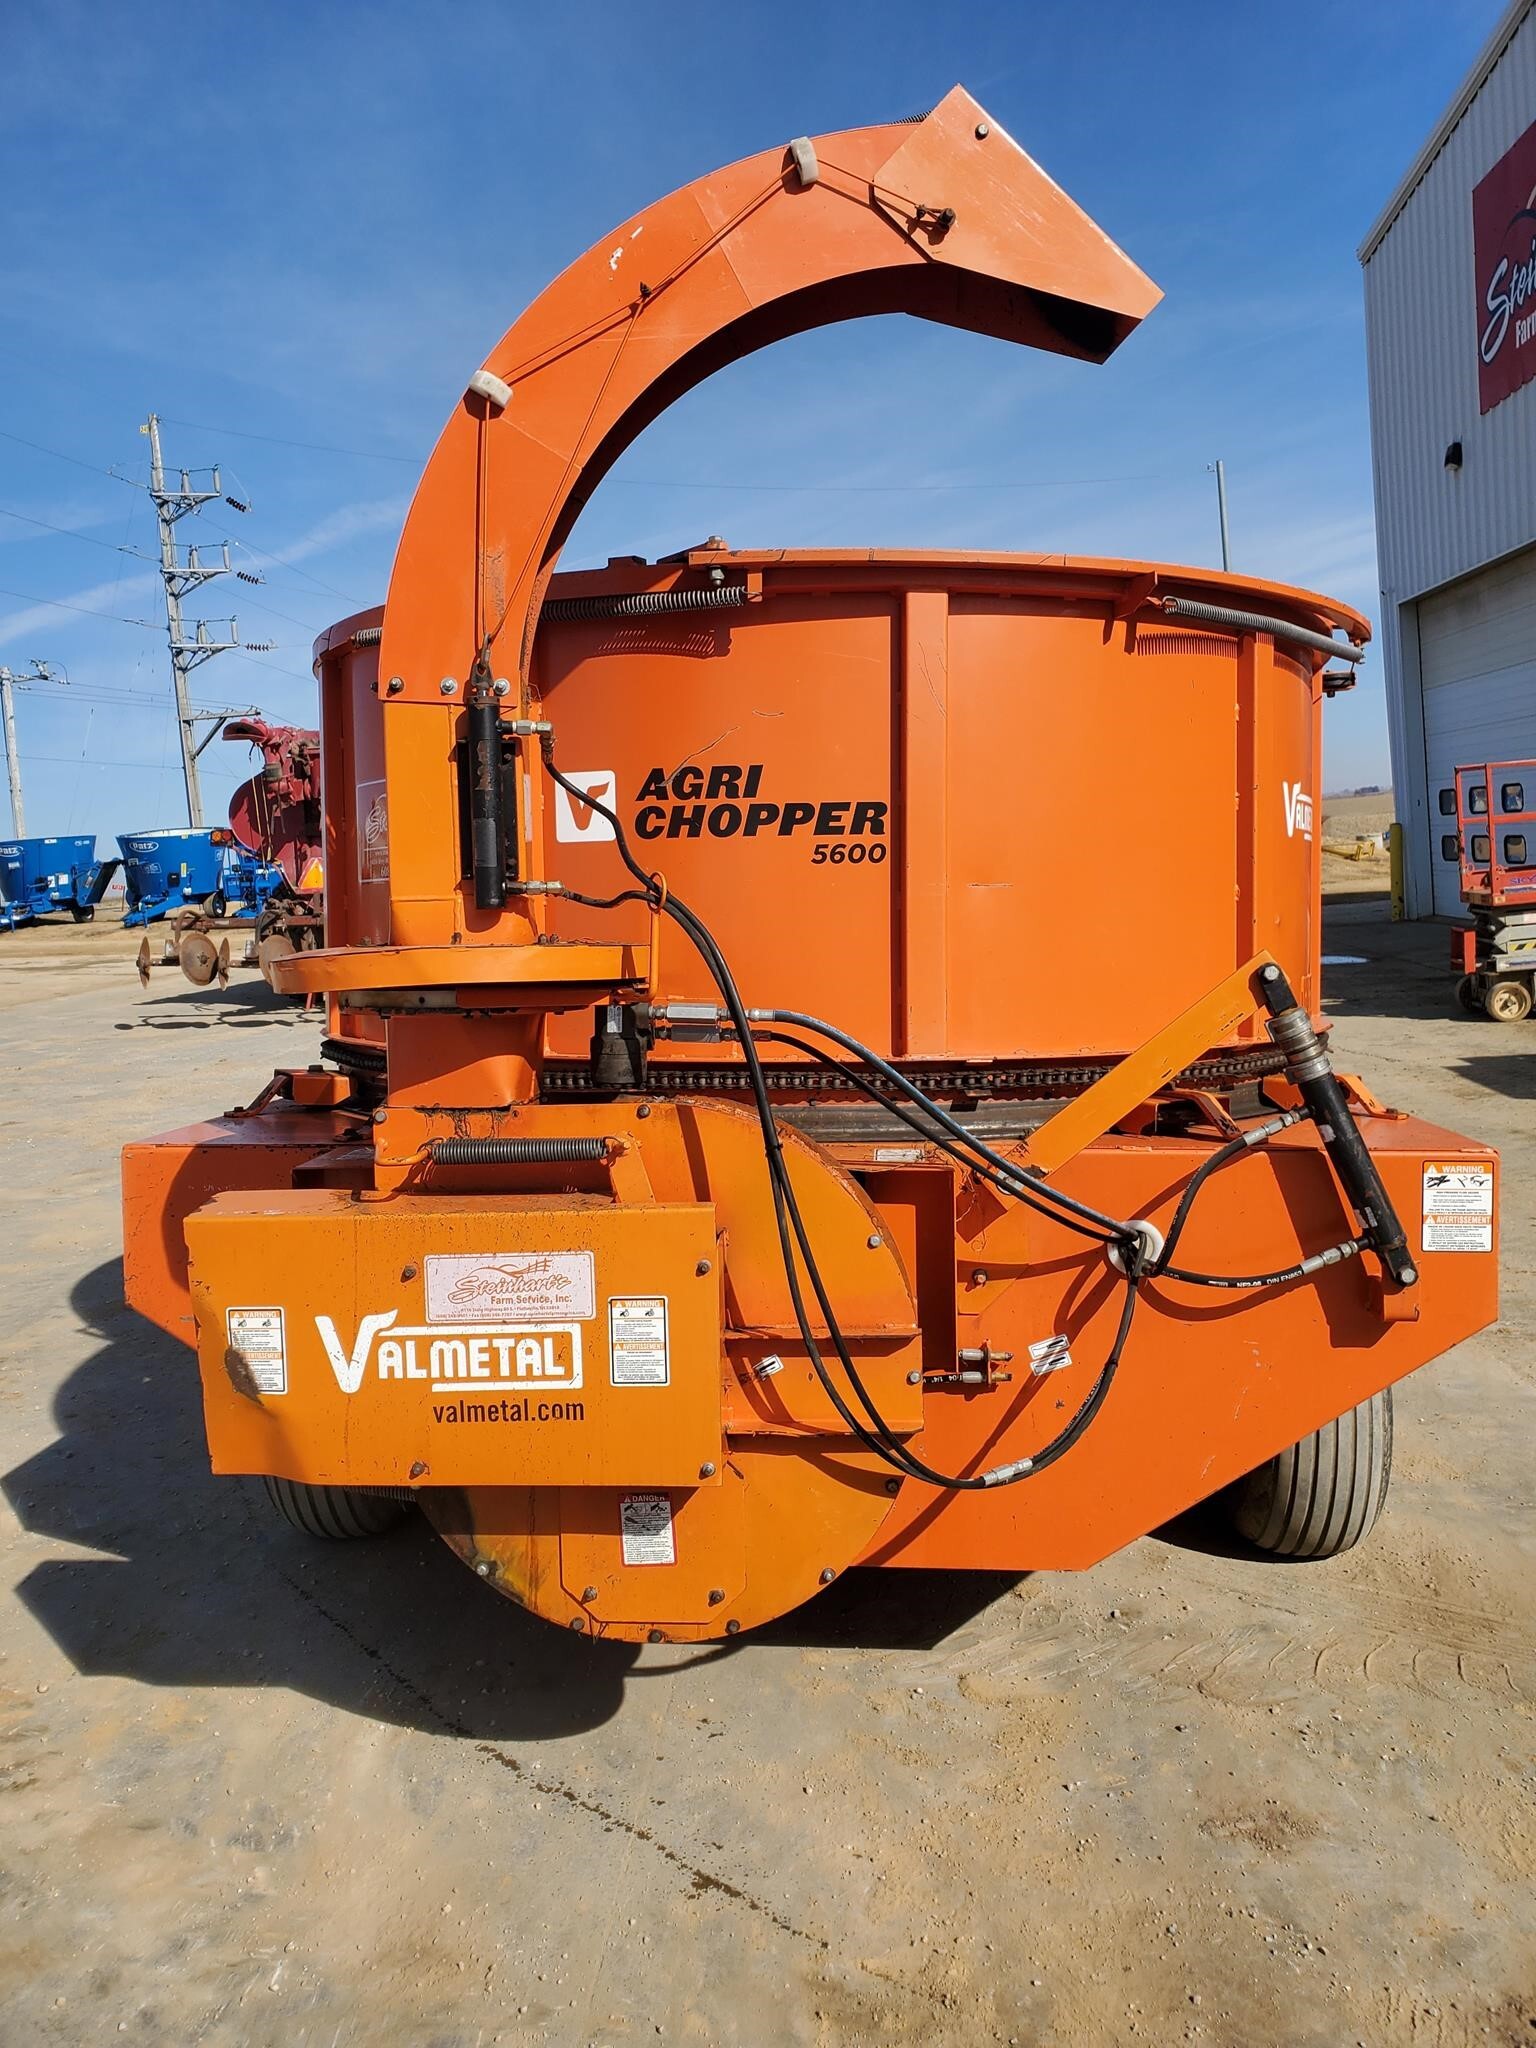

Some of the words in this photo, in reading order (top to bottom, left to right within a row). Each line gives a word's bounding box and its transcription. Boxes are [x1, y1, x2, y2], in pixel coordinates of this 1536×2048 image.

[636, 764, 764, 801] AGRI
[634, 801, 888, 839] CHOPPER
[810, 842, 886, 865] 5600
[1441, 1165, 1485, 1174] WARNING
[1436, 1216, 1490, 1225] AVERTISSEMENT
[447, 1273, 572, 1304] Steinhart's
[490, 1295, 514, 1305] Farm
[516, 1293, 553, 1304] Service,
[555, 1293, 572, 1303] Inc.
[314, 1308, 565, 1394] VALMETAL
[432, 1399, 585, 1423] valmetal.com
